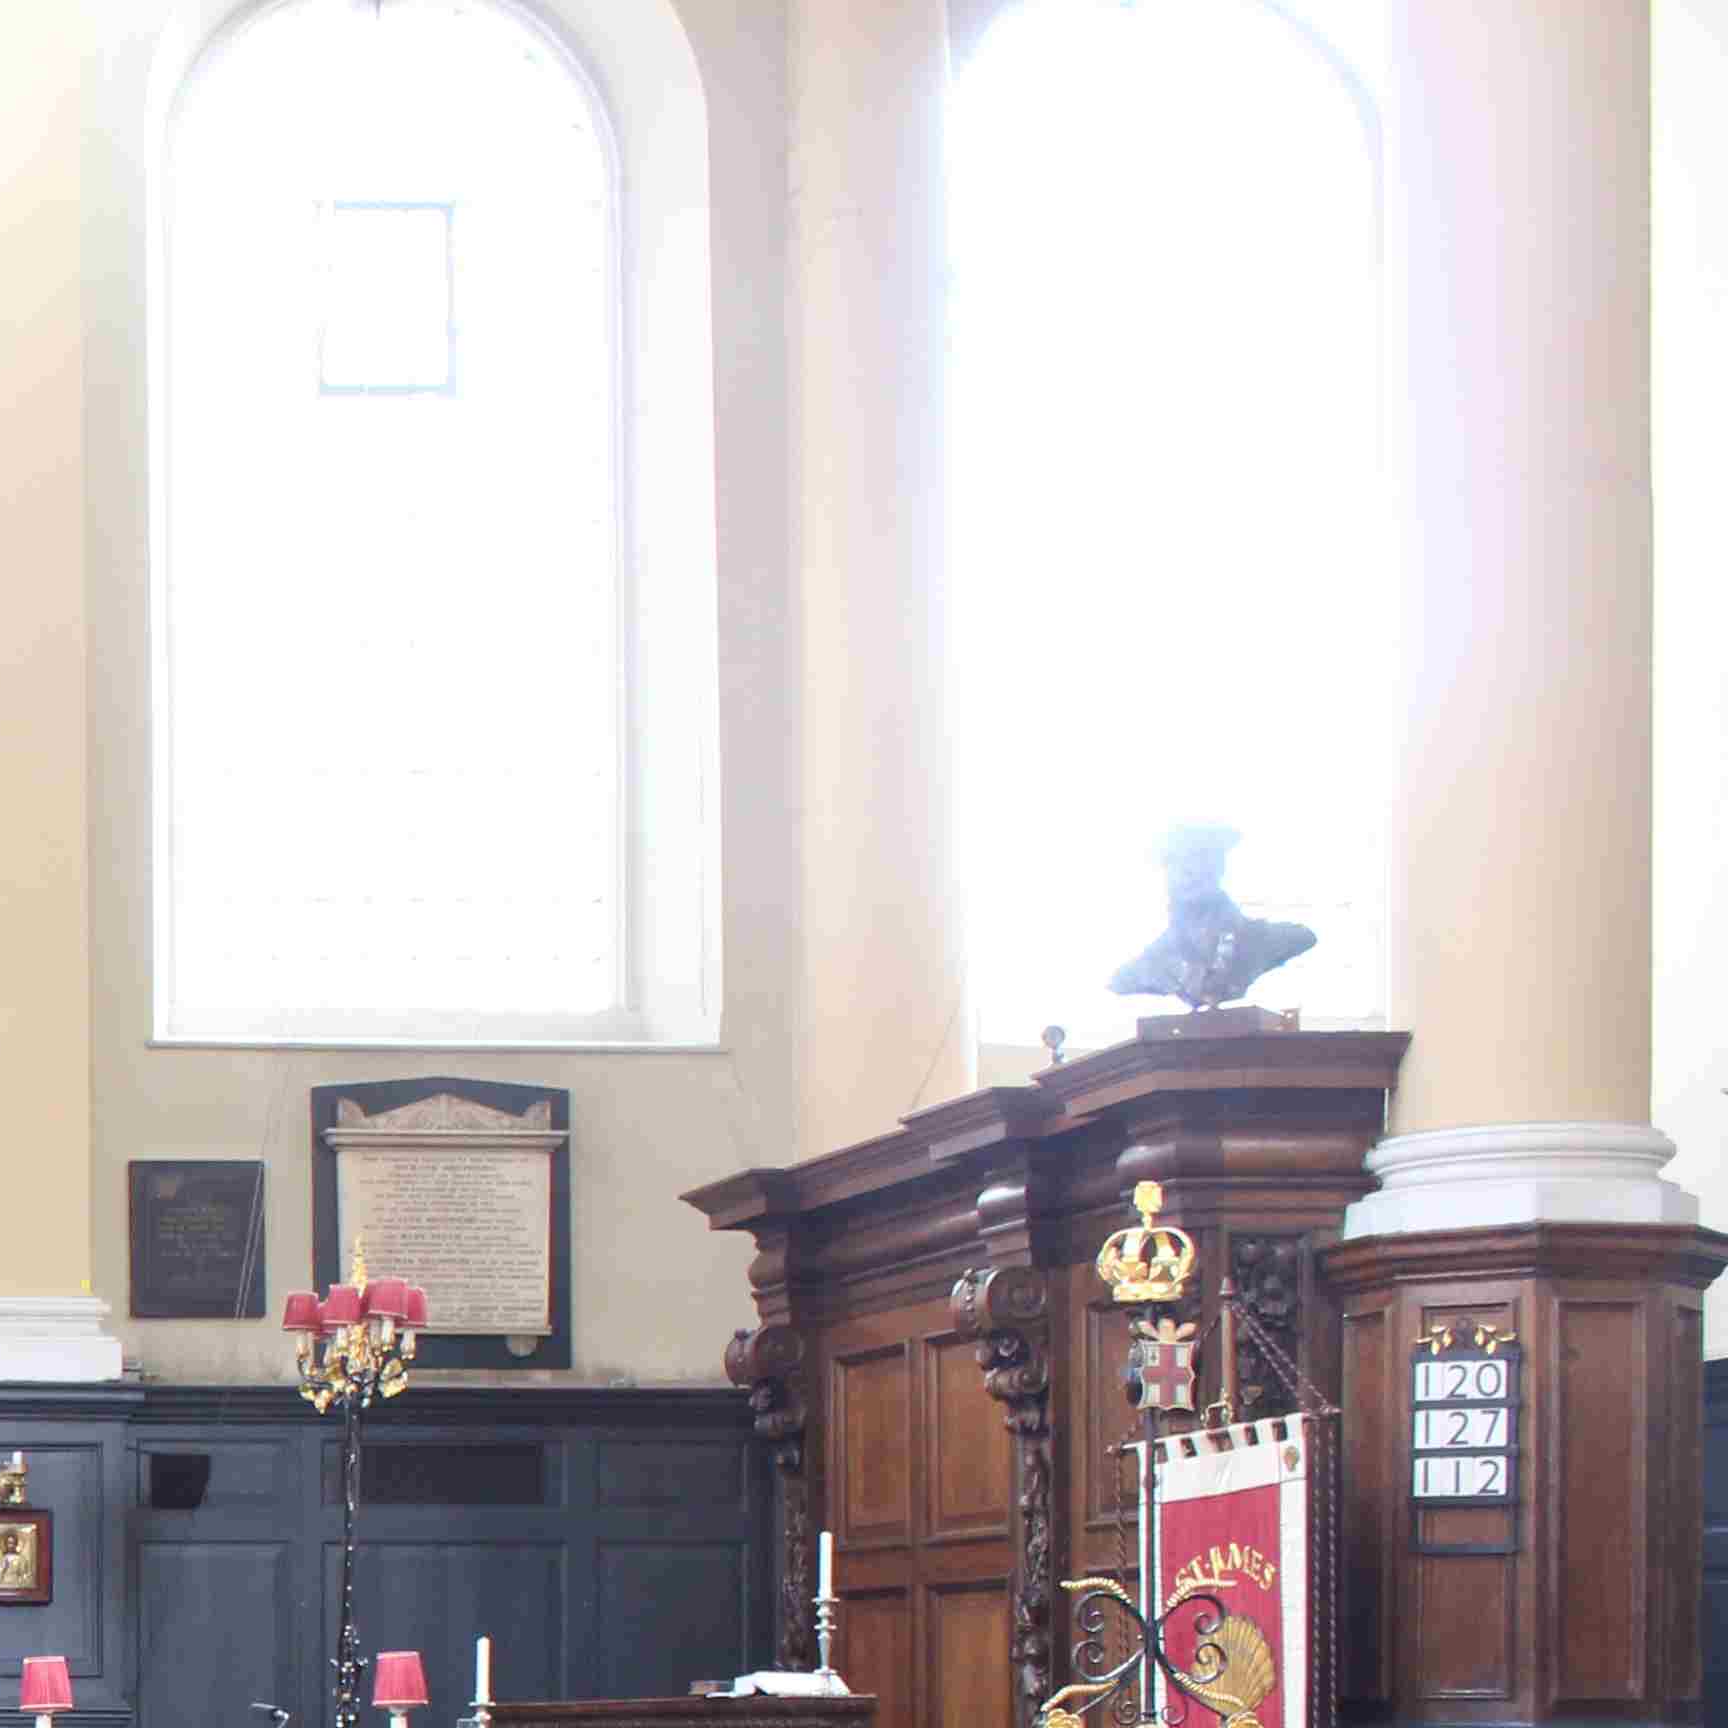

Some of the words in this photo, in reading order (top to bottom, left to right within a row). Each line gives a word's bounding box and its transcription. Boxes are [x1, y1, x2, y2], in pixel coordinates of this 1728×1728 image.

[1424, 1362, 1502, 1399] 120
[1424, 1409, 1502, 1445] 127
[1423, 1459, 1500, 1494] 112
